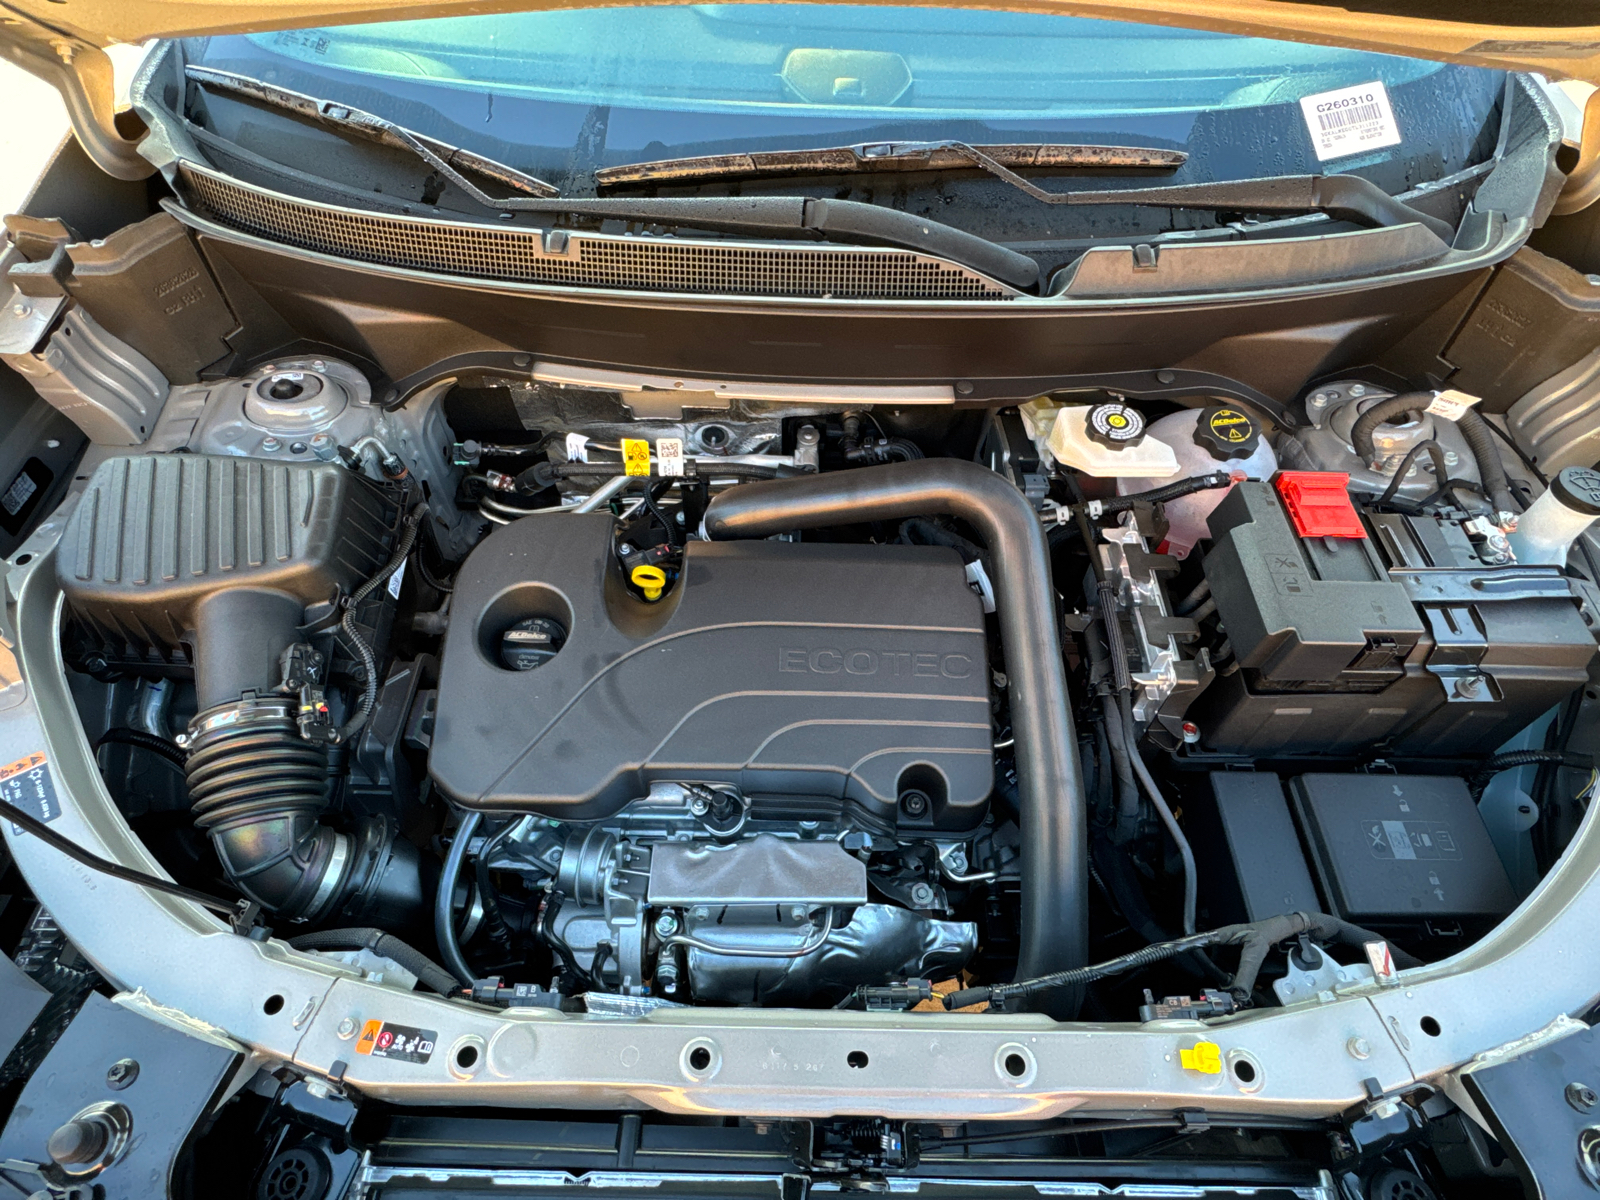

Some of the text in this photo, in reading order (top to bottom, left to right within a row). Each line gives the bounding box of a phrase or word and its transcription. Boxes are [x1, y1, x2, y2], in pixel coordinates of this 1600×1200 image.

[1316, 94, 1374, 113] G260310
[508, 631, 547, 640] ACDelco
[779, 647, 972, 679] ECOTEC
